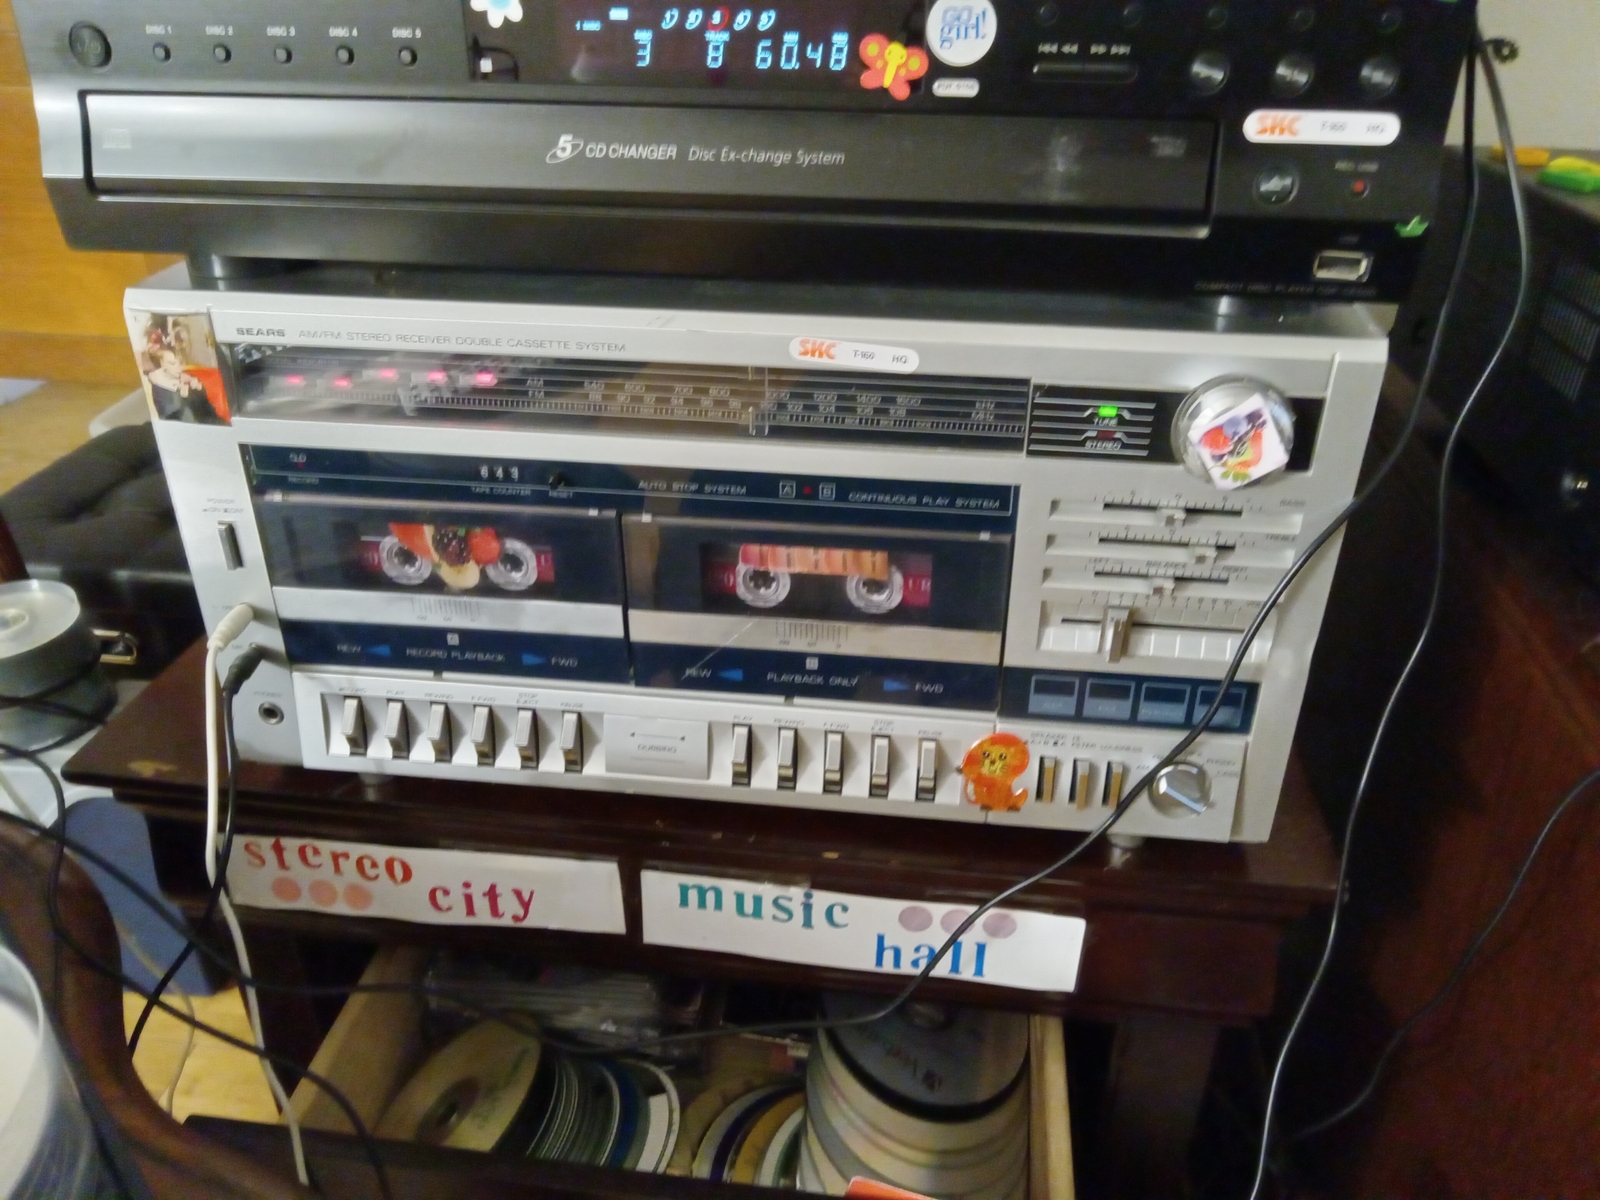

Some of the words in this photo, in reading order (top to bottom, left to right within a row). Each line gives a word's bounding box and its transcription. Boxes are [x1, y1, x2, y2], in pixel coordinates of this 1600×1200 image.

[939, 7, 986, 50] girl!
[706, 41, 726, 68] 8
[585, 142, 607, 158] CD
[608, 142, 678, 160] CHANGER
[688, 145, 716, 162] Disc
[720, 146, 793, 167] Ex-change
[795, 148, 846, 168] System
[236, 327, 286, 338] SEARS
[298, 330, 342, 341] AM/FM
[346, 332, 392, 343] STEREO
[395, 334, 451, 345] RECEIVER
[455, 336, 502, 348] DOUBLE
[506, 338, 572, 351] CASSETTE
[575, 341, 626, 353] SYSTEM
[797, 338, 836, 360] SKC
[528, 390, 545, 400] FM
[1093, 418, 1119, 428] TUNE
[1085, 440, 1122, 451] STEREO
[638, 480, 667, 491] AUTO
[671, 481, 699, 493] STOP
[704, 483, 747, 496] SYSTEM
[848, 491, 917, 505] CONTINUOUS
[922, 495, 950, 507] PLAY
[955, 497, 1000, 510] SYSTEM
[767, 672, 824, 686] PLAYBACK
[828, 676, 859, 688] ONLY
[244, 836, 413, 884] stereo
[429, 880, 535, 923] city
[678, 882, 850, 929] music
[874, 932, 988, 978] hall
